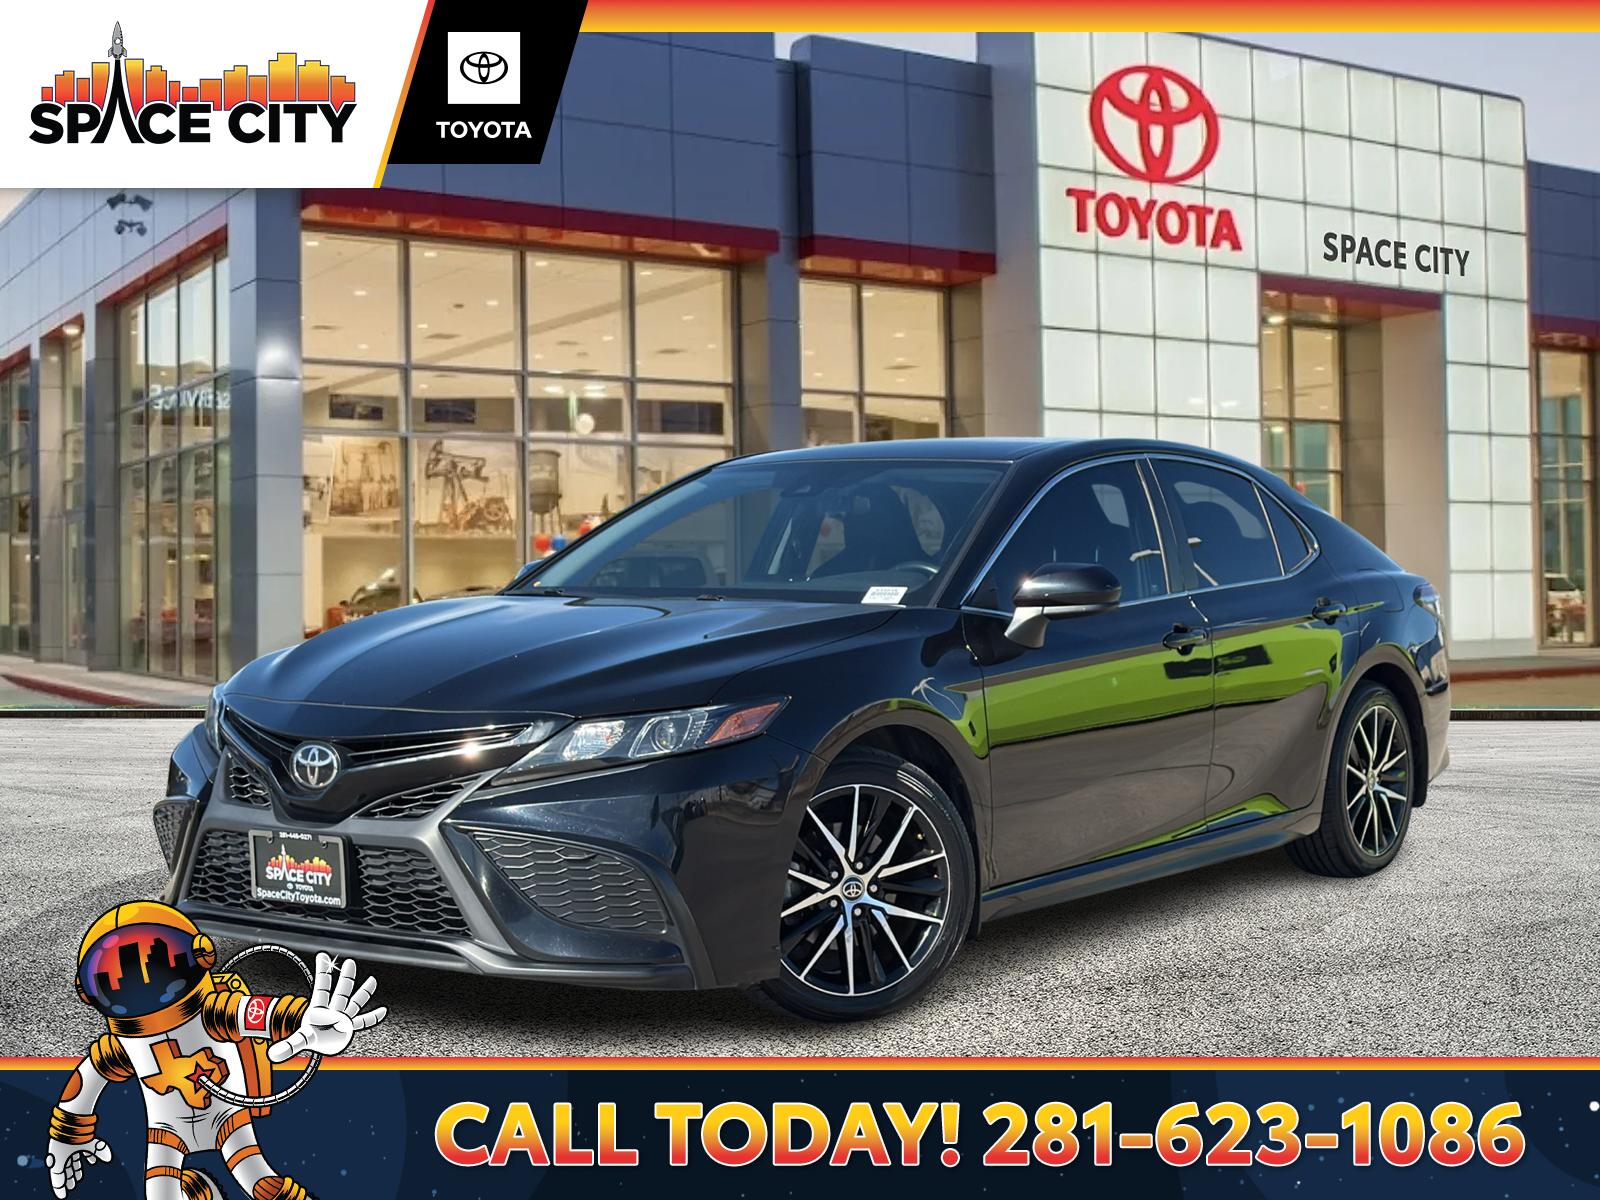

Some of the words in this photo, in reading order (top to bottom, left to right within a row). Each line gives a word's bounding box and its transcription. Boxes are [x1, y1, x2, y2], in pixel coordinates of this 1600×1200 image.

[1066, 187, 1243, 252] TOYOTA
[1323, 232, 1407, 270] SPACE
[1414, 244, 1471, 277] CITY
[266, 867, 305, 882] SPACE
[306, 871, 332, 886] CITY
[257, 887, 341, 906] SpaceCityToyota.com
